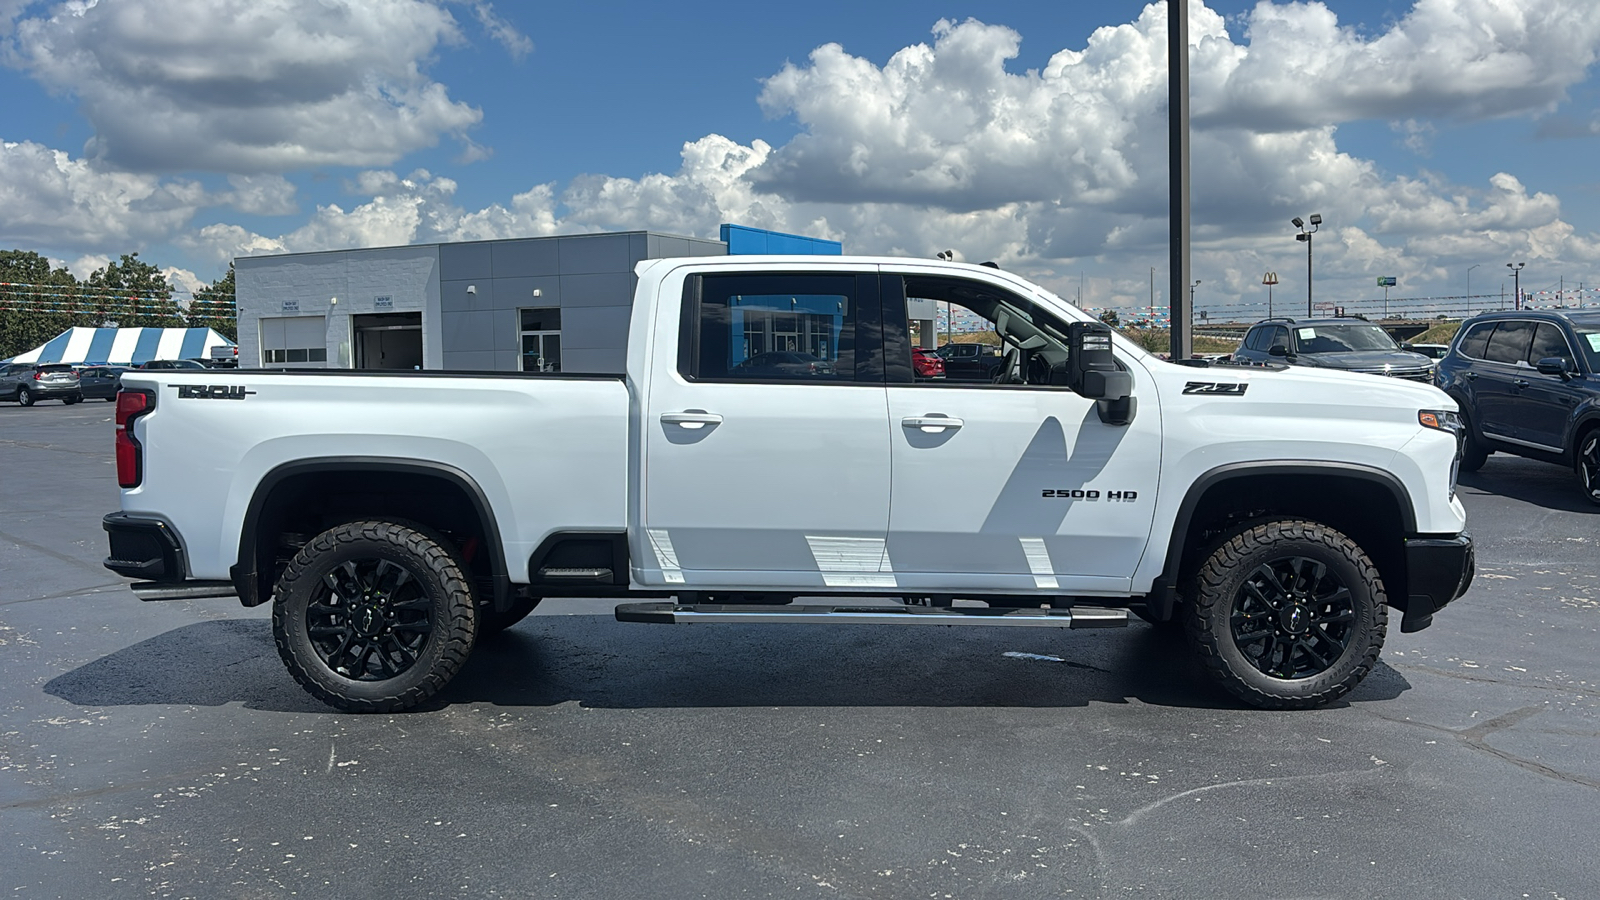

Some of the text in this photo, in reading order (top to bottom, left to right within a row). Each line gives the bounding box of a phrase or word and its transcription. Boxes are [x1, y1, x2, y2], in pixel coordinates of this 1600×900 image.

[1182, 381, 1249, 396] Z71
[1042, 489, 1138, 499] 2500 HD
